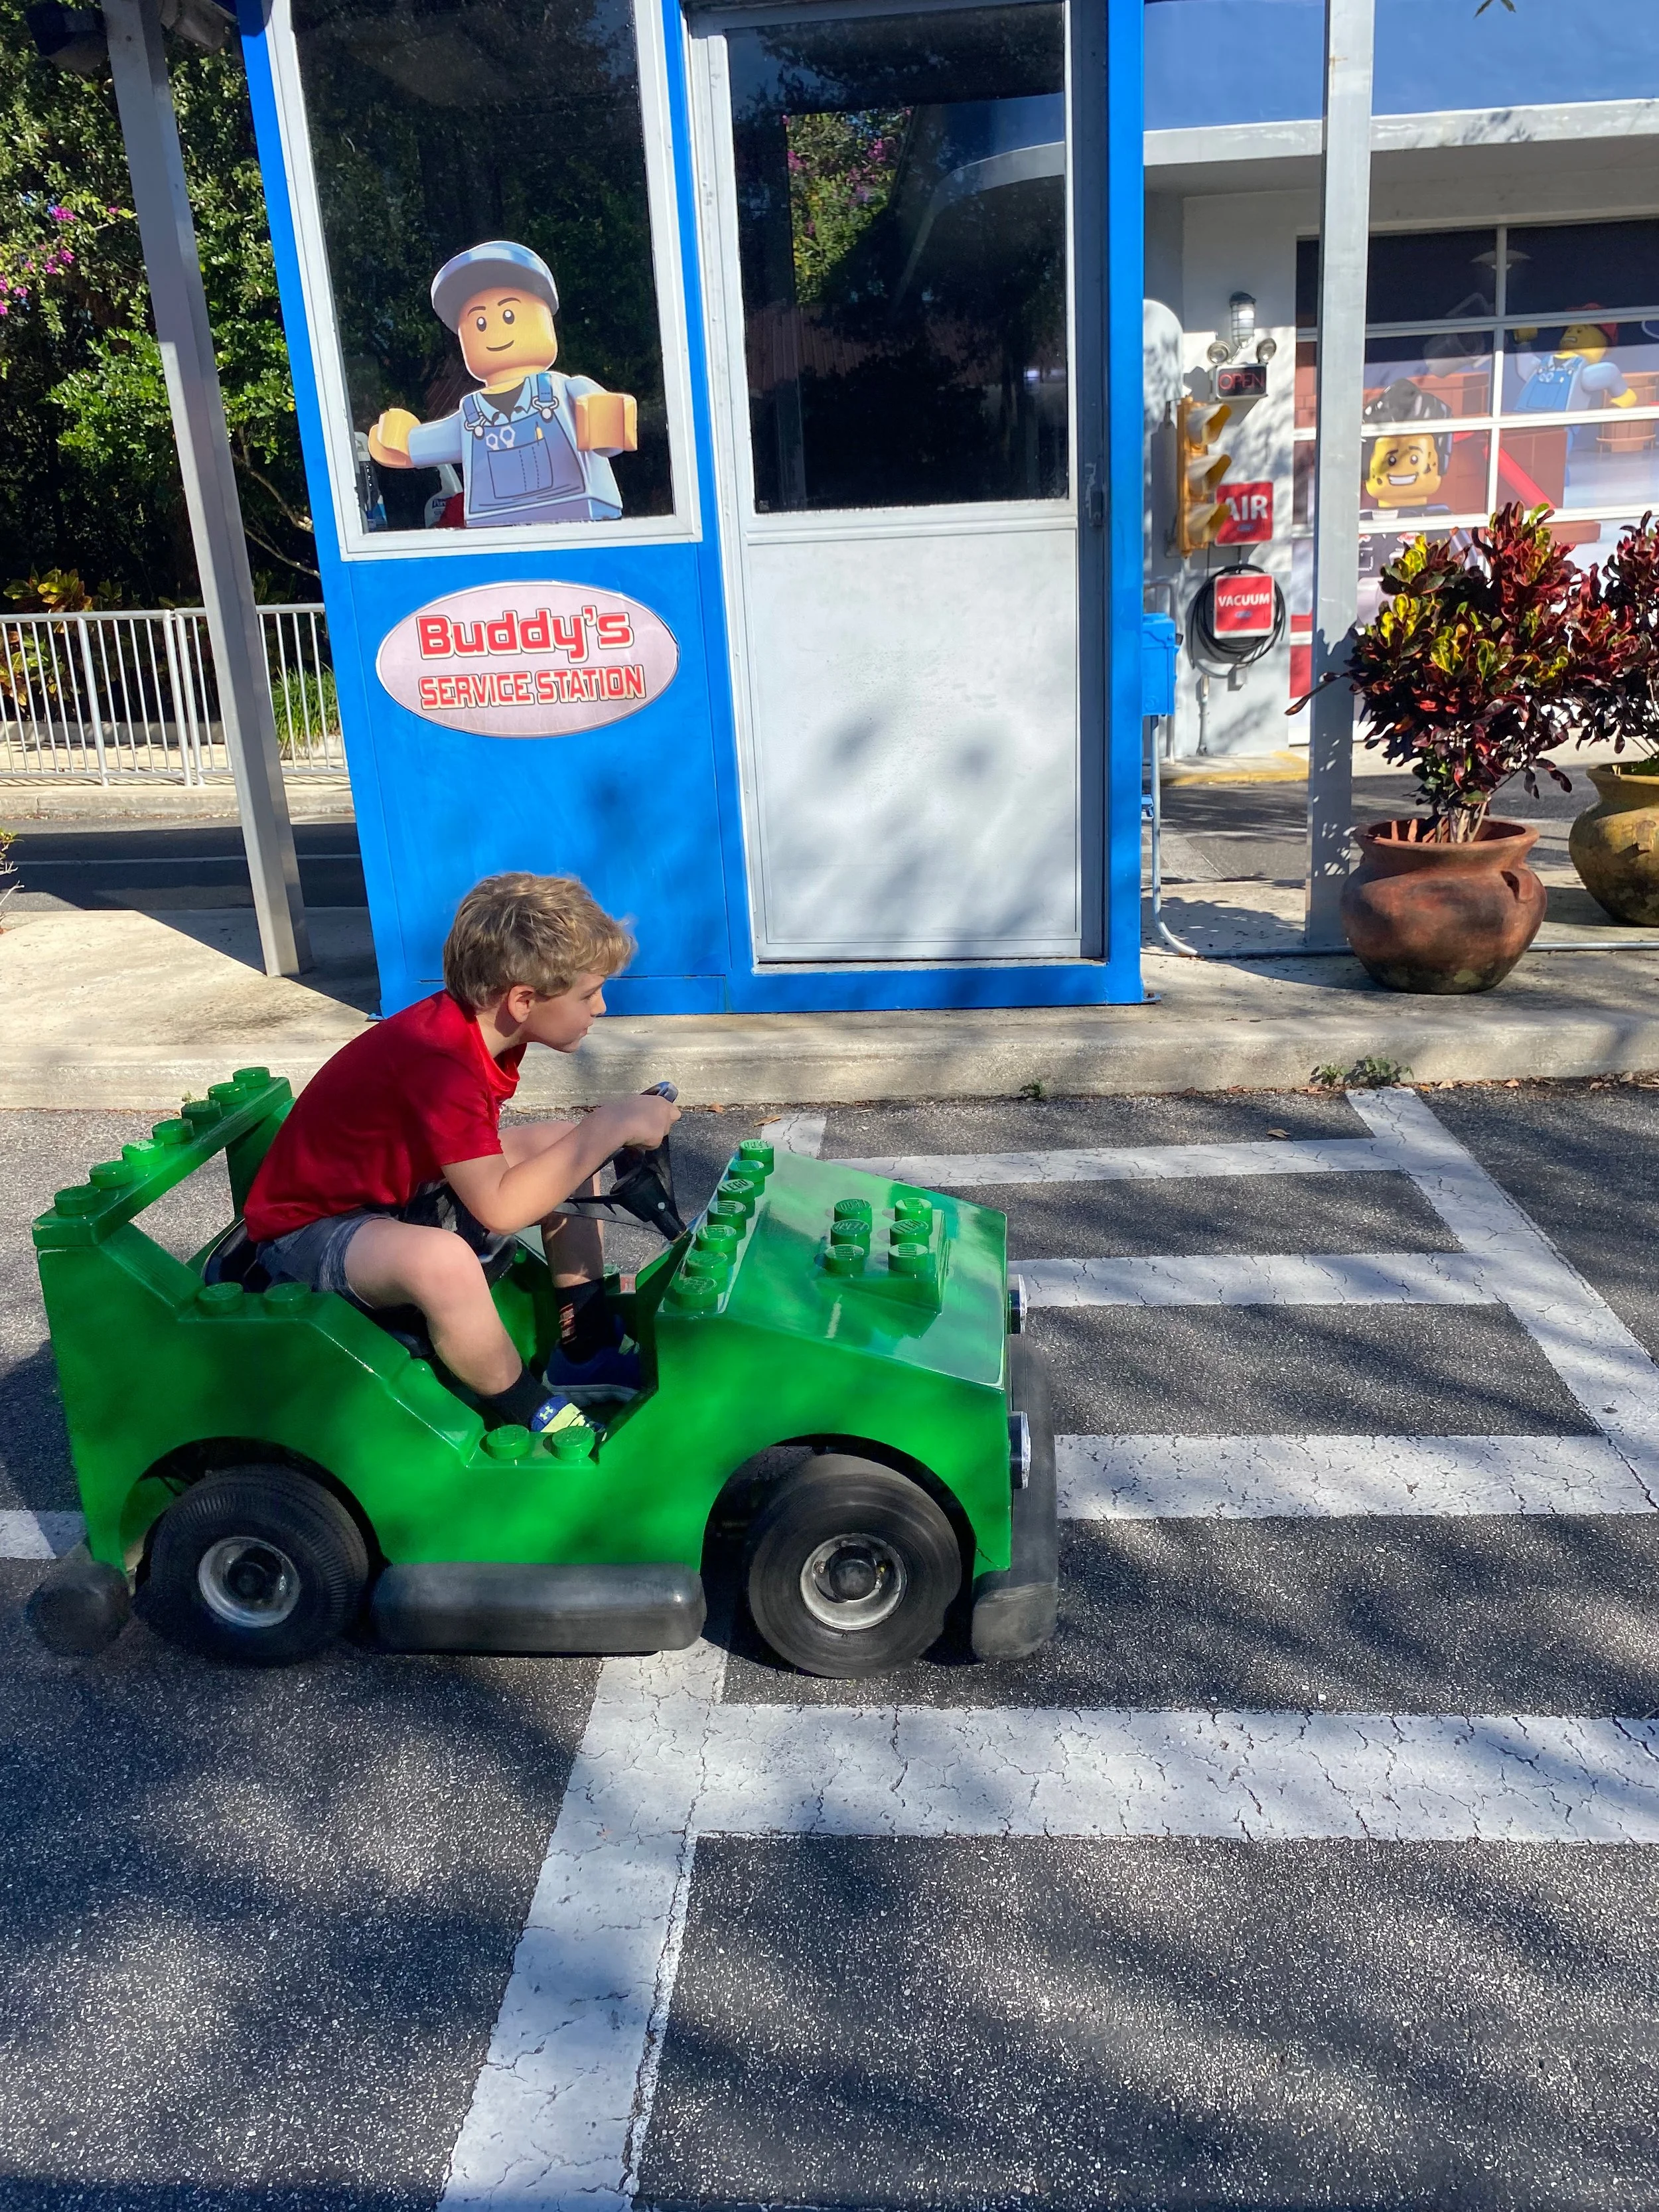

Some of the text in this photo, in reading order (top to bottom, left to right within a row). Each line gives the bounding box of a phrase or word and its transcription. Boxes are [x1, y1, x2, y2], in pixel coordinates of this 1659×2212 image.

[1219, 373, 1265, 390] OPEN
[1225, 494, 1268, 522] AIR
[1218, 593, 1270, 607] VACUUM
[417, 606, 634, 663] Buddy's
[419, 664, 646, 709] SERVICE STATION
[721, 1179, 749, 1192] LEGO
